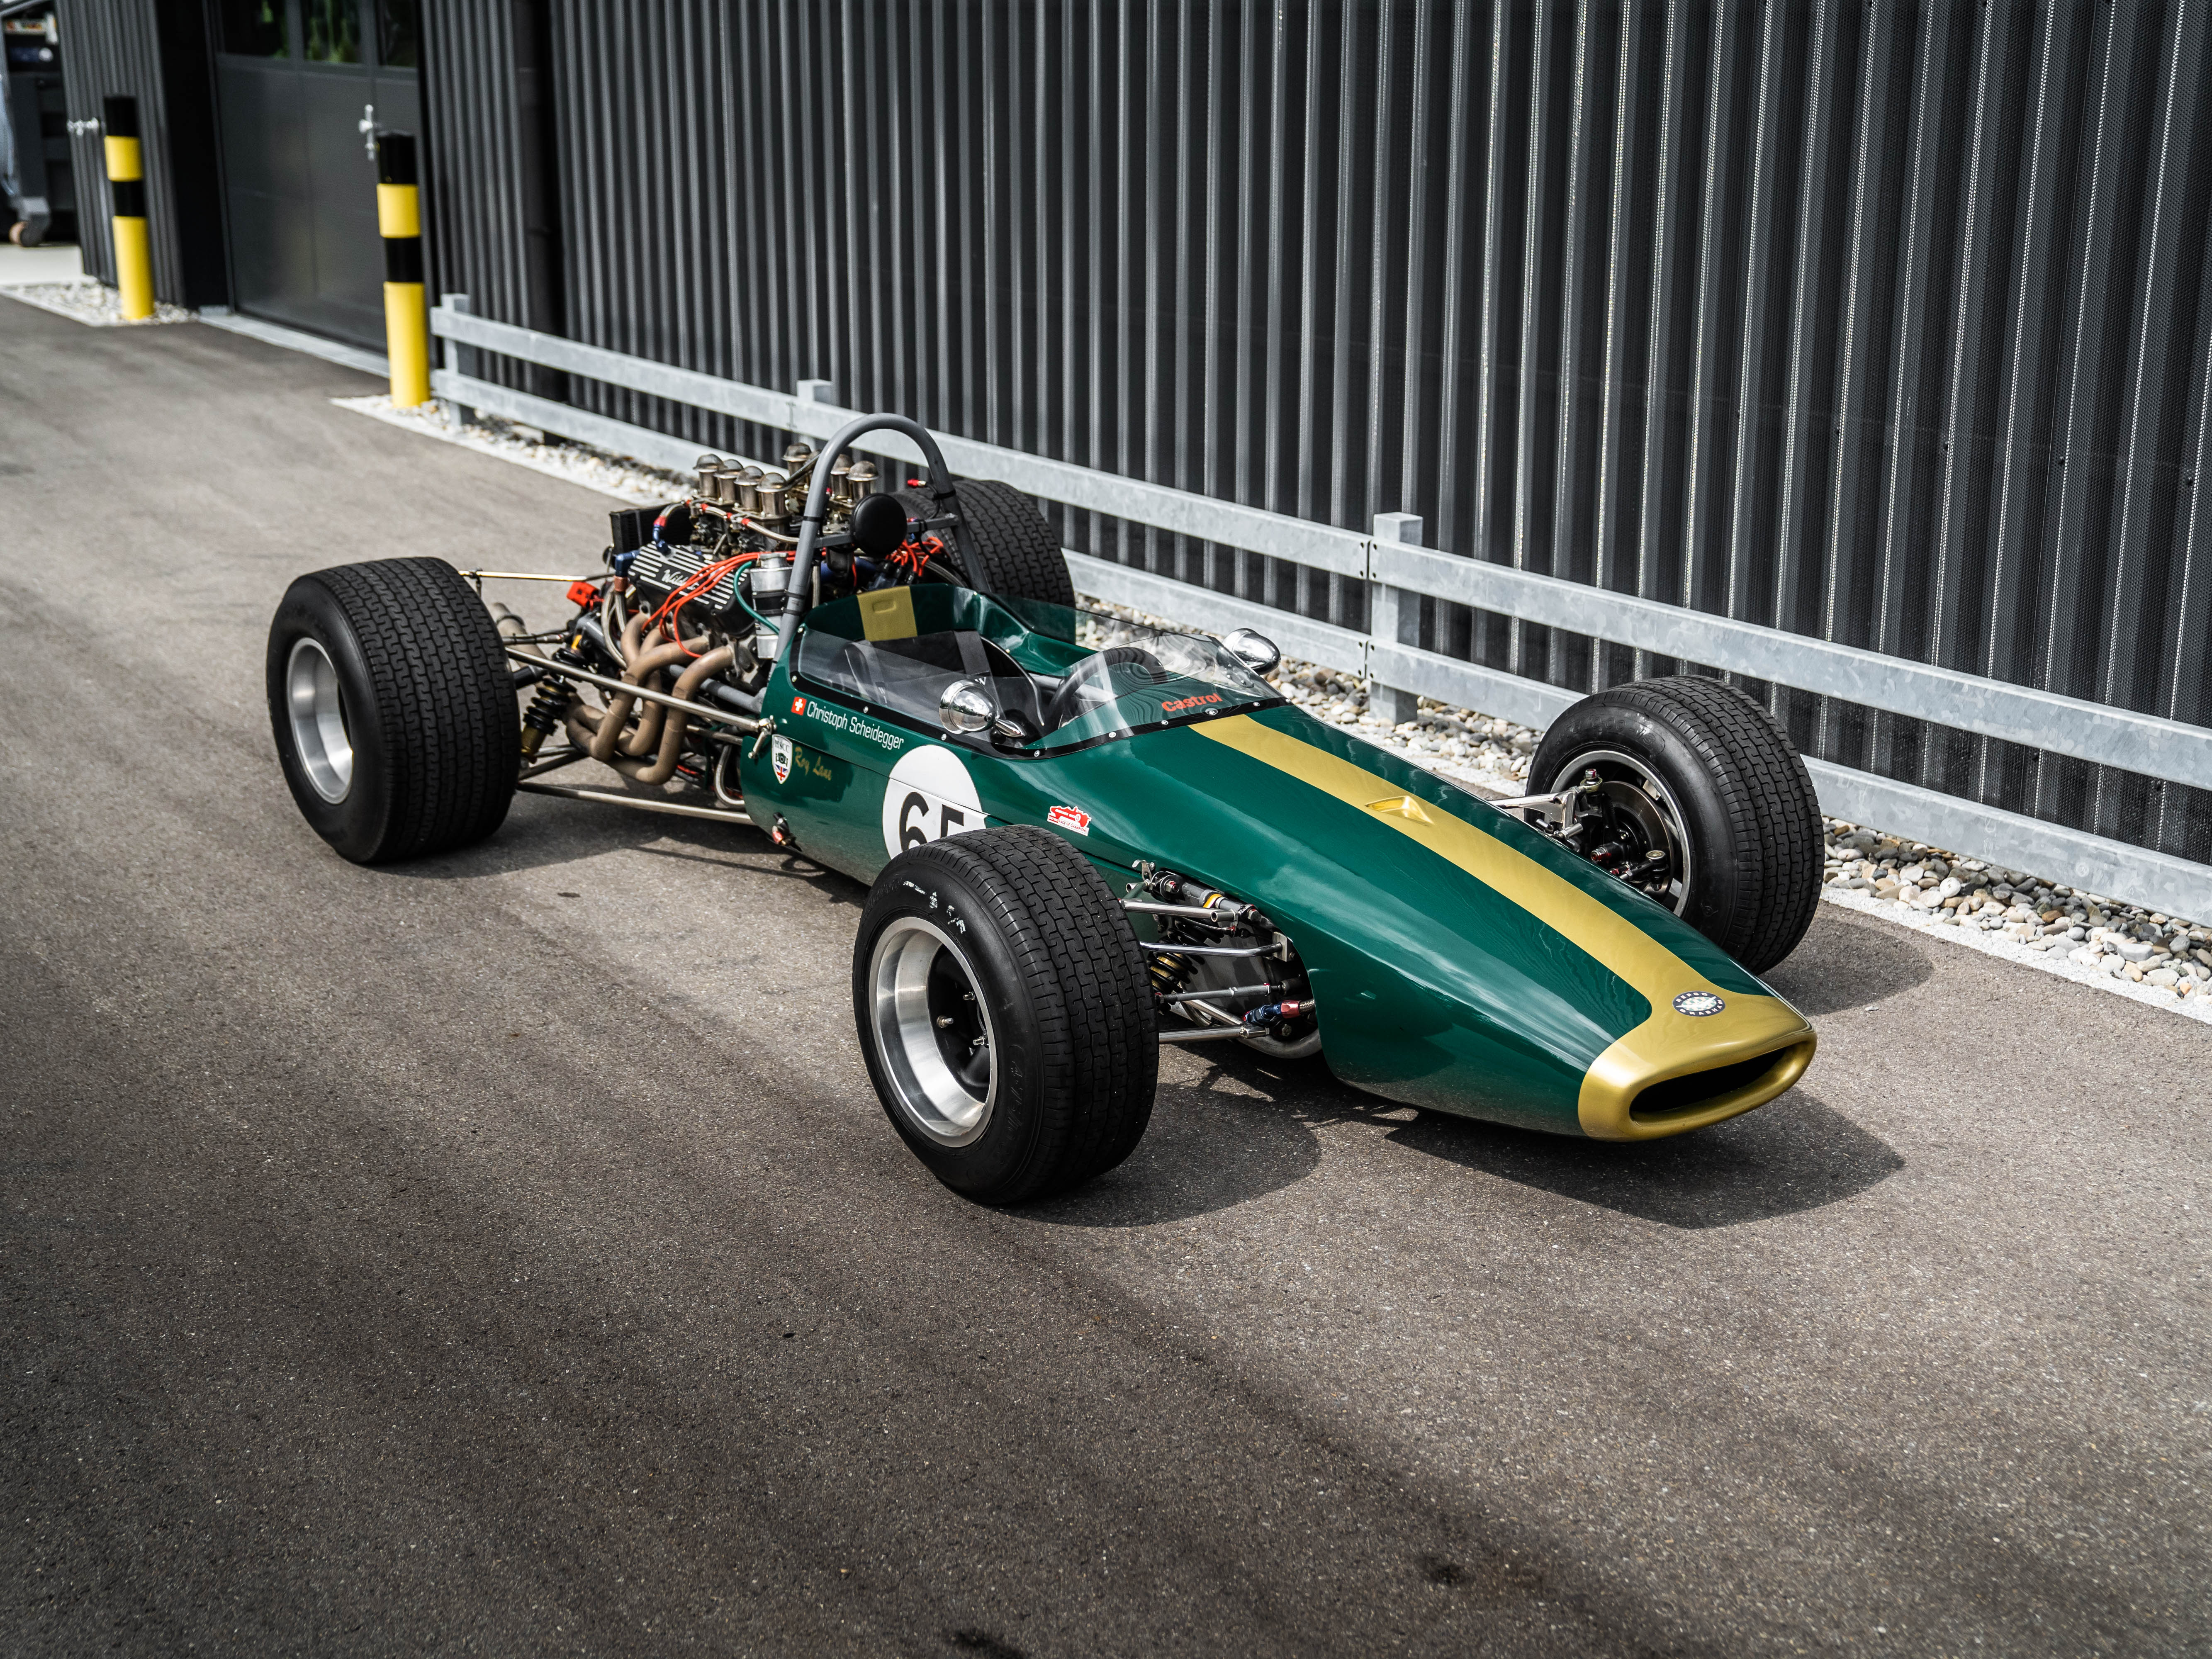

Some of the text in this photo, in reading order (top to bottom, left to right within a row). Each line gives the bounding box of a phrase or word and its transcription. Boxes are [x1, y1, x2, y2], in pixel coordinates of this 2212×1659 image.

[1162, 693, 1223, 712] Castrol
[807, 701, 904, 750] Christoph Scheidegger
[775, 740, 790, 753] HSCC
[1676, 992, 1708, 1002] REPCO
[1680, 999, 1723, 1015] BRABHAM
